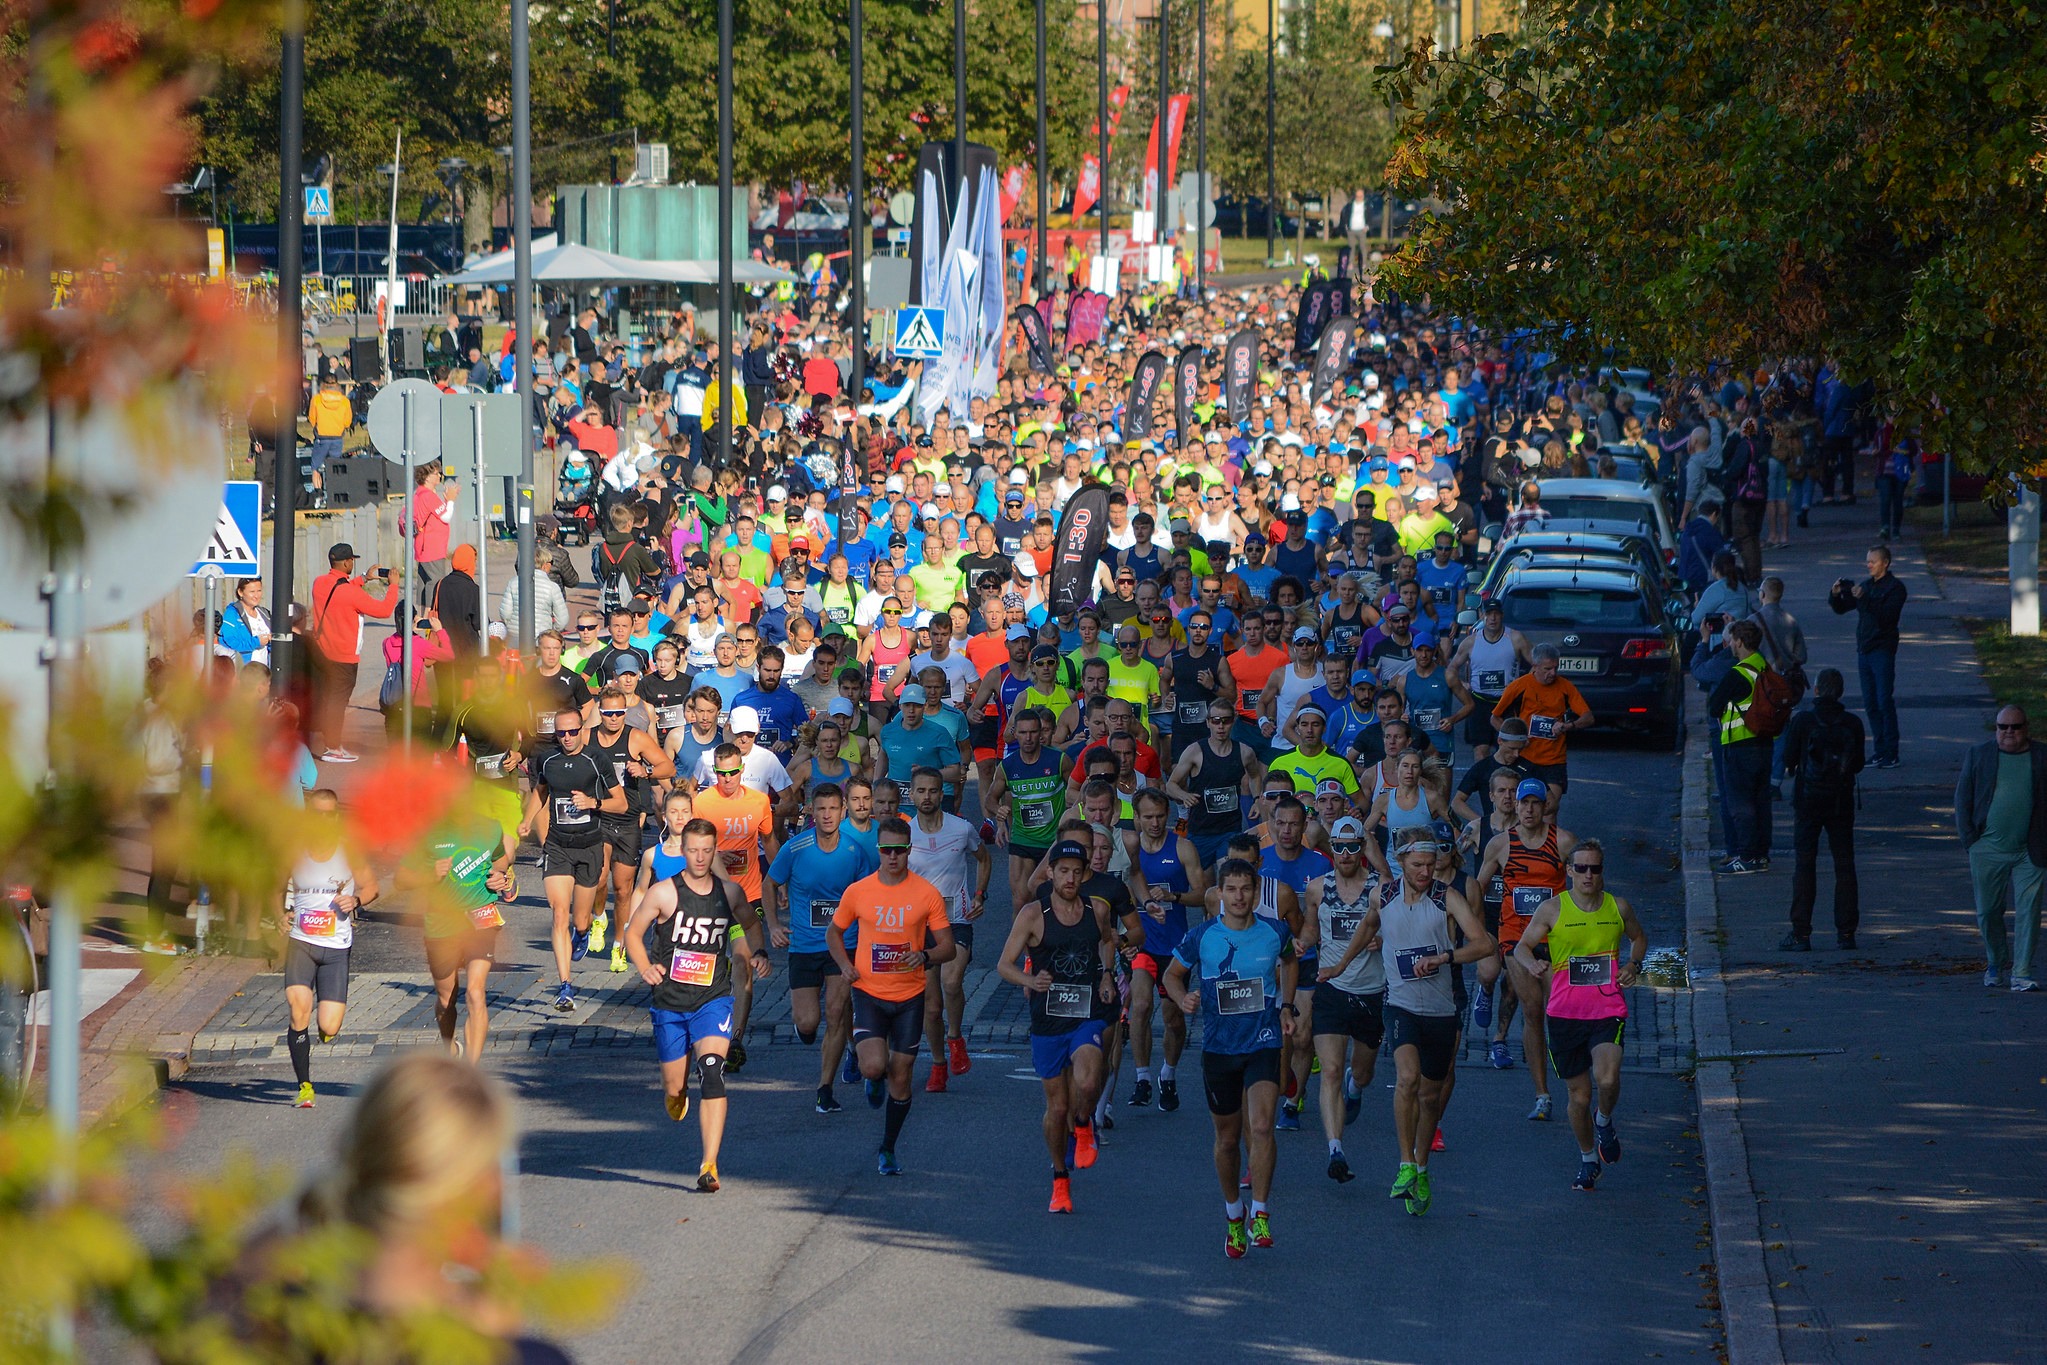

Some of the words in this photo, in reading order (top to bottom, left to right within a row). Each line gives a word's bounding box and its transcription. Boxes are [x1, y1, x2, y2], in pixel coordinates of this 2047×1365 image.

[1327, 329, 1347, 369] 3:45
[1235, 346, 1250, 387] 1:50
[1063, 508, 1092, 565] 1:30
[1186, 707, 1200, 715] 1705
[1011, 780, 1057, 793] LIETUVA
[1213, 794, 1230, 802] 1096
[1028, 808, 1044, 817] 1214
[1523, 894, 1541, 903] 840
[303, 915, 332, 926] 3005-1
[877, 951, 906, 961] 3017-
[678, 958, 710, 973] 3001-1
[1580, 963, 1601, 974] 1792
[1058, 992, 1080, 1003] 1922
[1229, 987, 1253, 1000] 1802
